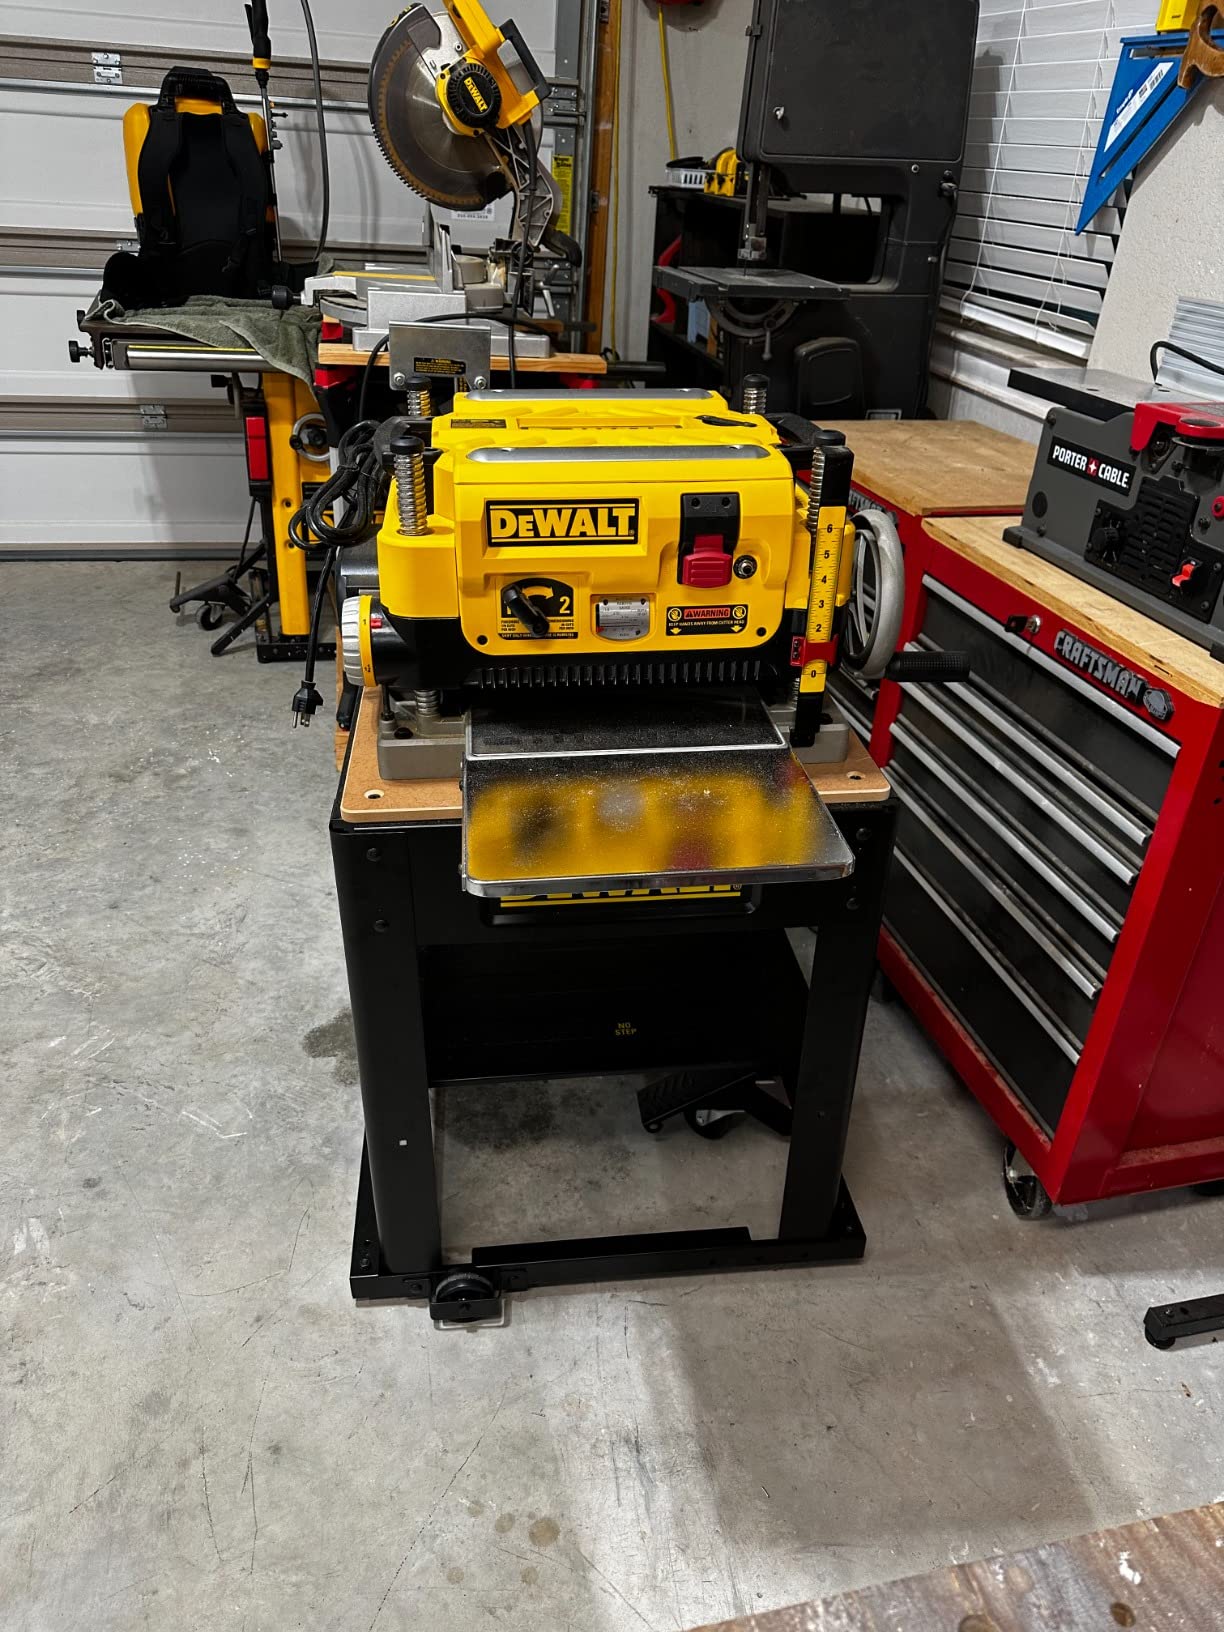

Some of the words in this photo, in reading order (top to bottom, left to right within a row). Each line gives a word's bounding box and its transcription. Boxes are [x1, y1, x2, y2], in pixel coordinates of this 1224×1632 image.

[1052, 445, 1088, 472] PORTER
[1098, 463, 1130, 489] CABLE
[826, 523, 833, 533] 6
[823, 550, 830, 559] 5
[821, 575, 827, 584] 4
[559, 596, 571, 614] 2
[818, 599, 825, 608] 3
[692, 609, 729, 618] WARNING
[816, 623, 822, 632] 2
[1054, 630, 1143, 702] CRAFTSMAN
[811, 669, 816, 678] 0
[615, 1028, 637, 1036] STEP
